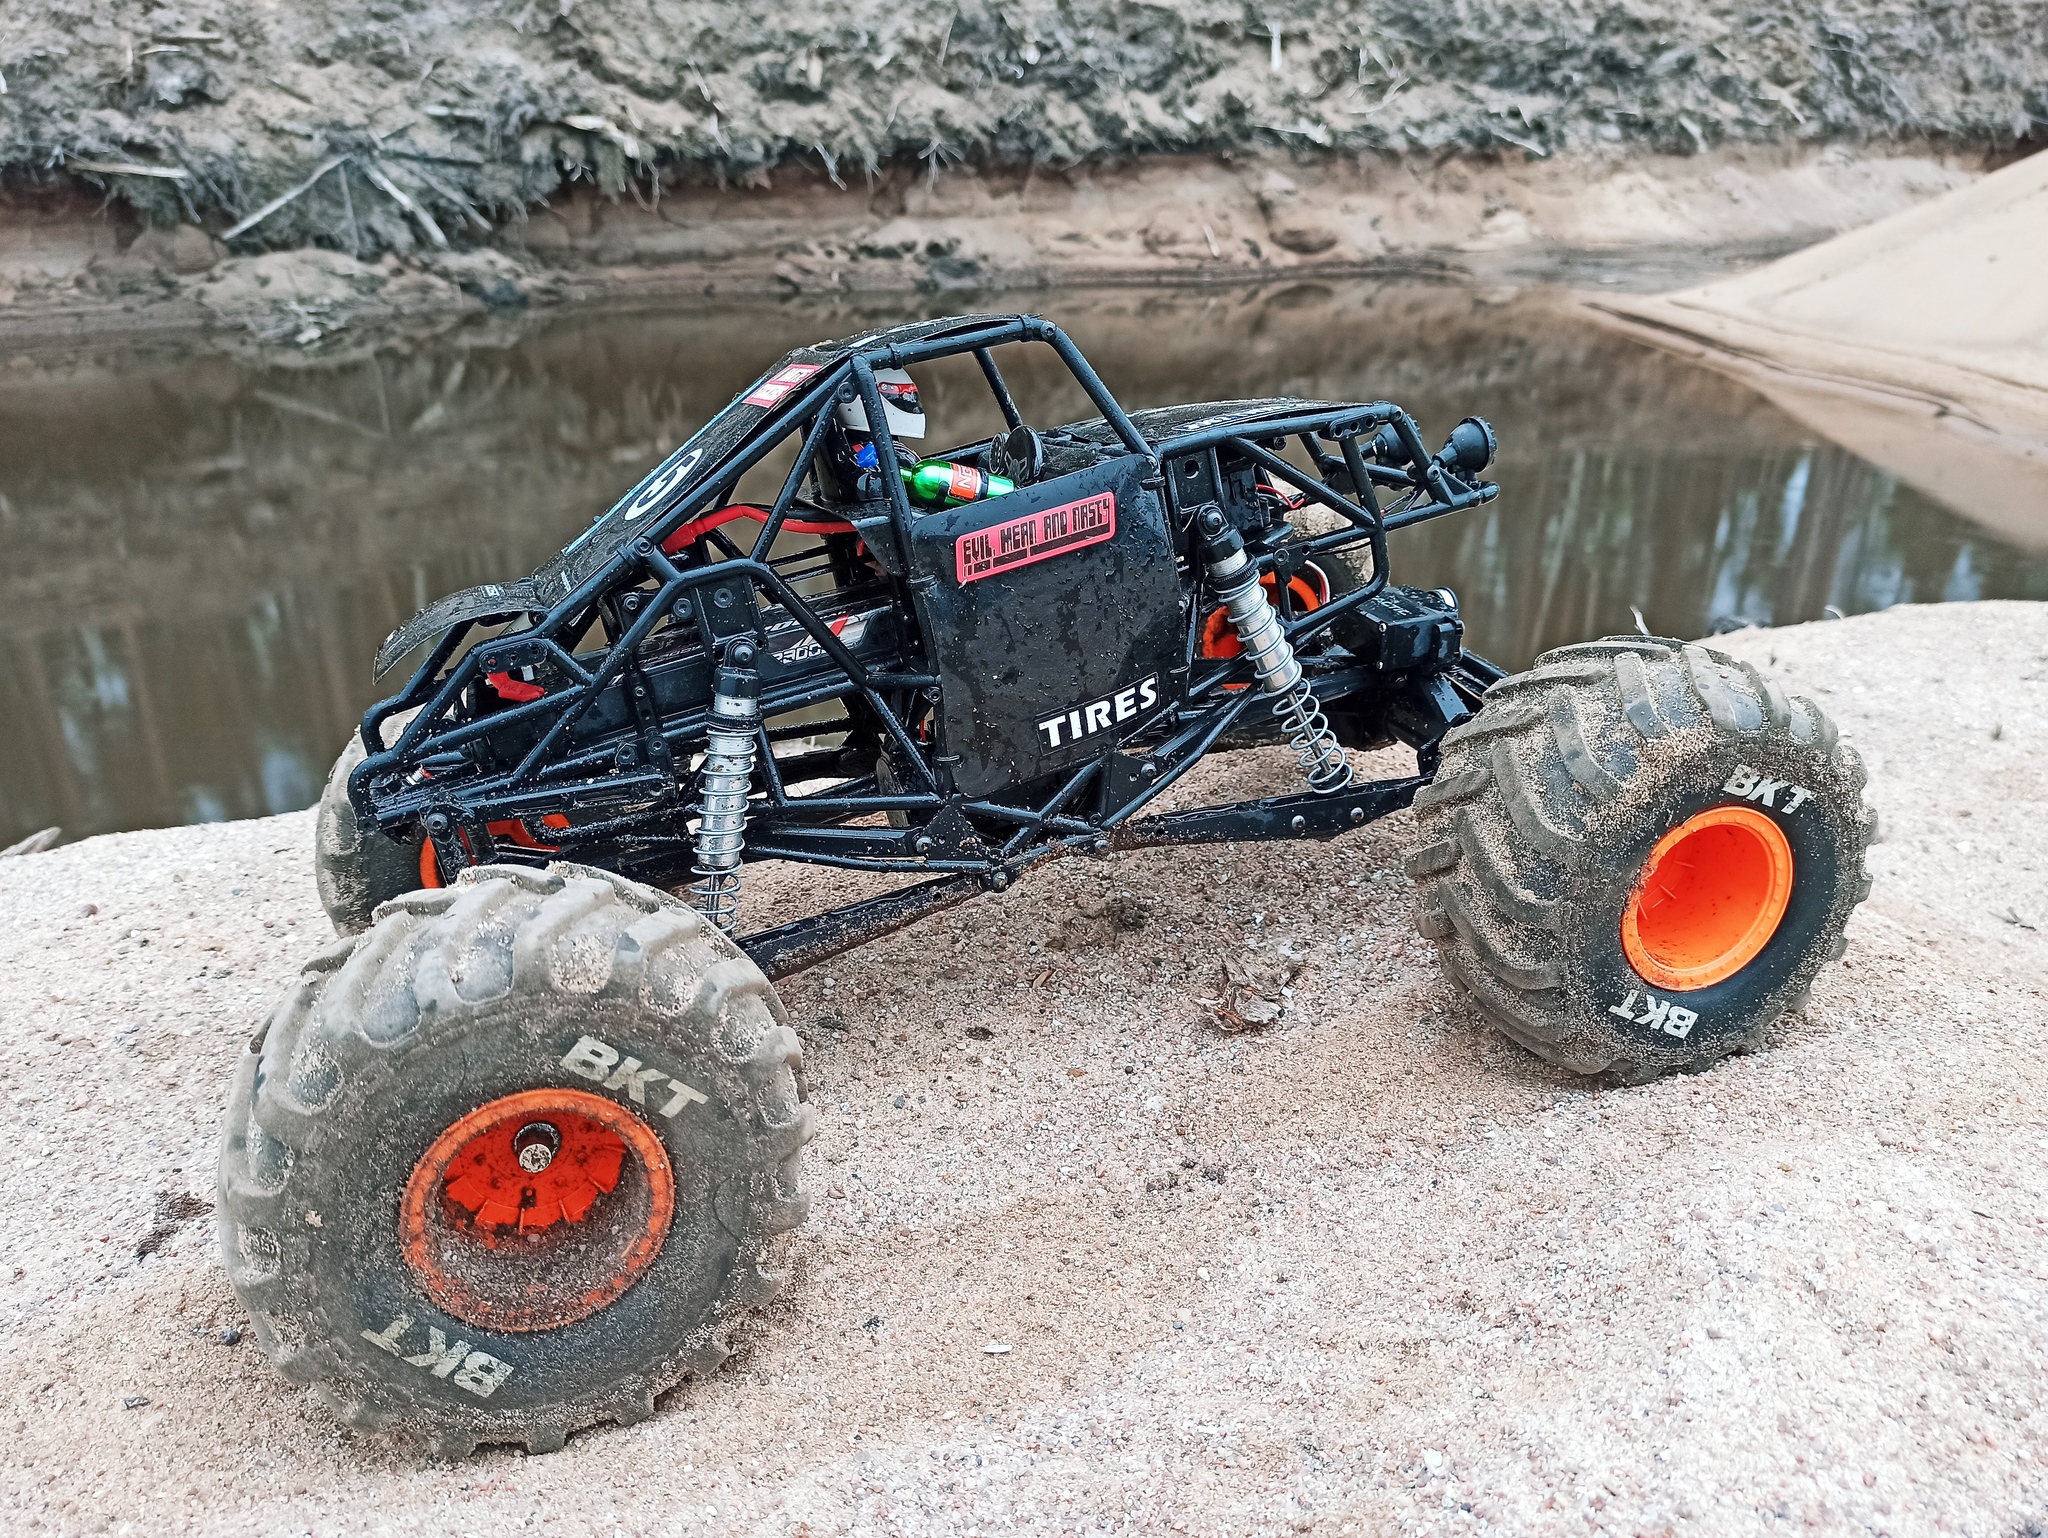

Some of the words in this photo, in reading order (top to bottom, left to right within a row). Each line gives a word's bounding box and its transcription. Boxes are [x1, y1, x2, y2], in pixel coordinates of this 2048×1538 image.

[1000, 520, 1036, 553] MEAN
[1043, 510, 1067, 540] AND
[1072, 498, 1110, 532] NASTY
[1038, 678, 1157, 748] TIRES
[1721, 764, 1814, 815] BKT
[1608, 989, 1699, 1039] BKT
[559, 1034, 709, 1119] BKT
[360, 1313, 514, 1399] BKT
